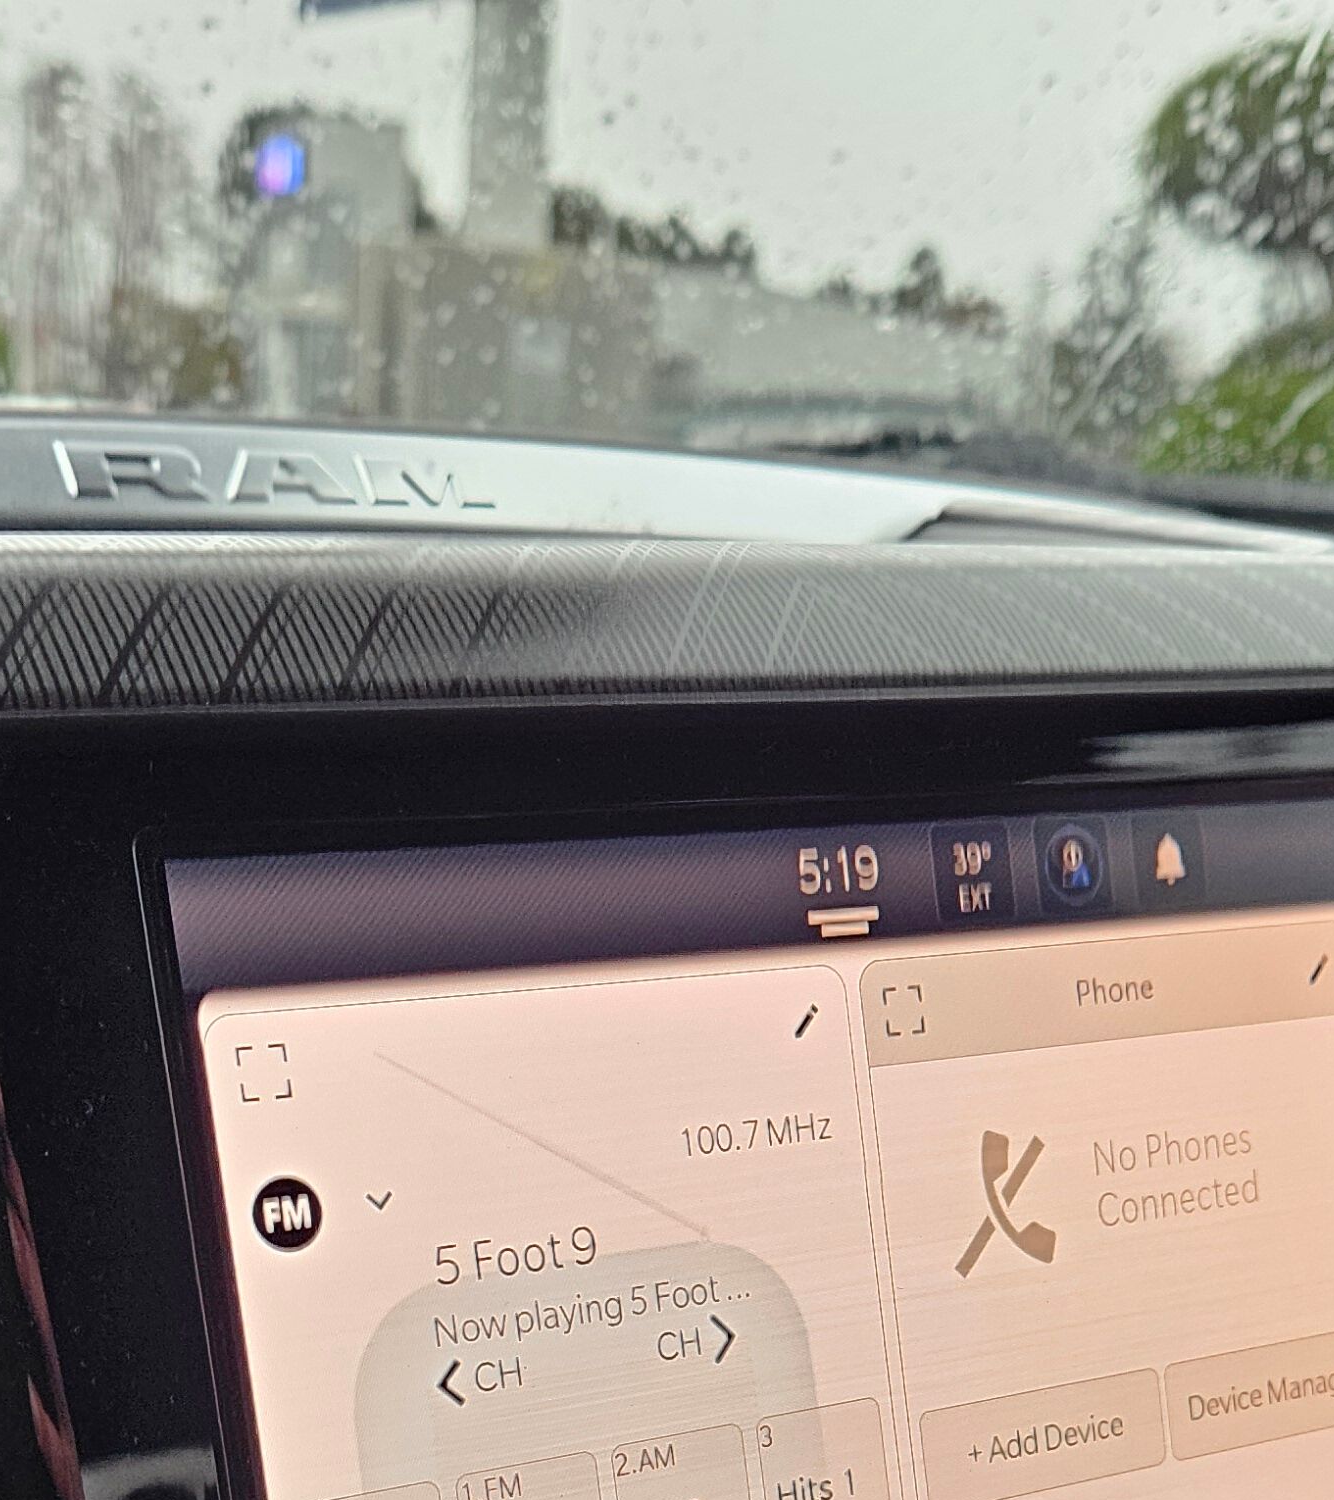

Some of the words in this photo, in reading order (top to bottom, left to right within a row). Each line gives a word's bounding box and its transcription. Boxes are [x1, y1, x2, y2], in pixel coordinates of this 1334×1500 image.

[52, 438, 496, 508] RAM
[798, 844, 879, 895] 5:19
[958, 882, 993, 913] EXT
[1075, 977, 1155, 1006] Phone
[681, 1120, 758, 1156] 100.7
[767, 1113, 833, 1145] MHz
[1092, 1140, 1138, 1175] No
[1147, 1127, 1253, 1168] Phones
[263, 1194, 312, 1234] FM
[1098, 1171, 1260, 1227] Connected
[435, 1244, 461, 1285] 5
[474, 1235, 564, 1281] Foot
[571, 1226, 597, 1265] 9
[434, 1314, 507, 1347] Now
[515, 1295, 624, 1341] playing
[630, 1287, 648, 1317] 5
[657, 1328, 702, 1361] CH
[474, 1358, 523, 1392] CH
[1188, 1386, 1264, 1421] Device
[760, 1425, 773, 1449] 3
[989, 1429, 1039, 1462] Add
[1046, 1413, 1125, 1452] Device
[614, 1446, 676, 1477] 2.AM
[846, 1469, 857, 1498] 1
